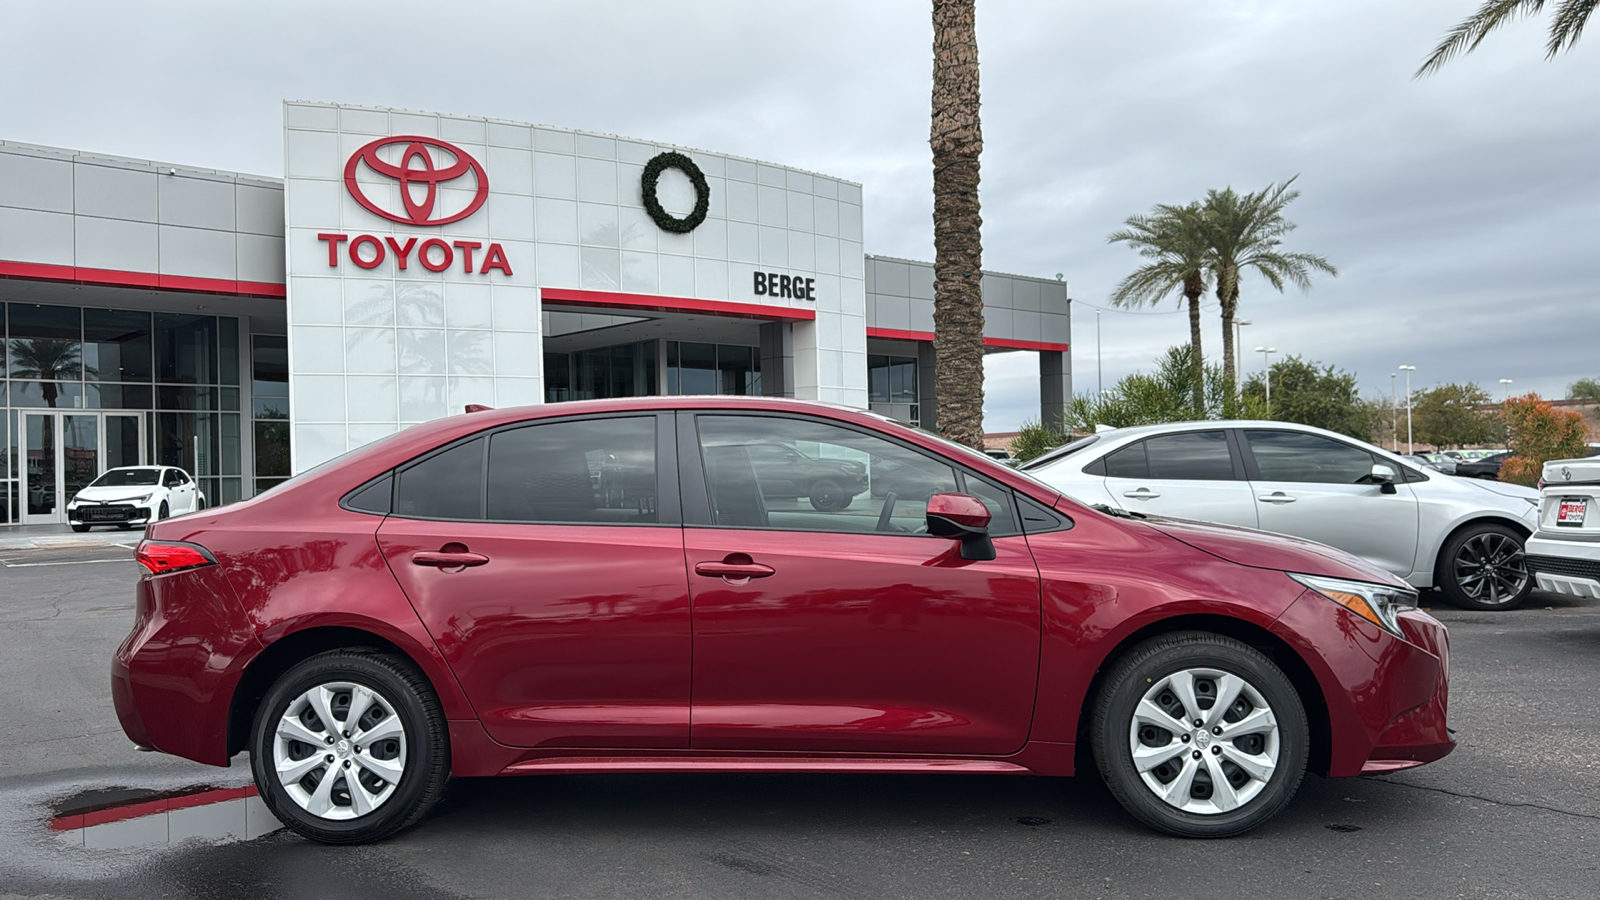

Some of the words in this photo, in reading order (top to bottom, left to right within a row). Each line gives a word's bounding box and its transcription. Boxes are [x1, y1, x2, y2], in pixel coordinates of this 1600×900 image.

[317, 233, 514, 276] TOYOTA
[753, 271, 816, 301] BERGE
[1566, 513, 1584, 521] TOYOTA
[1567, 504, 1586, 513] BERGE
